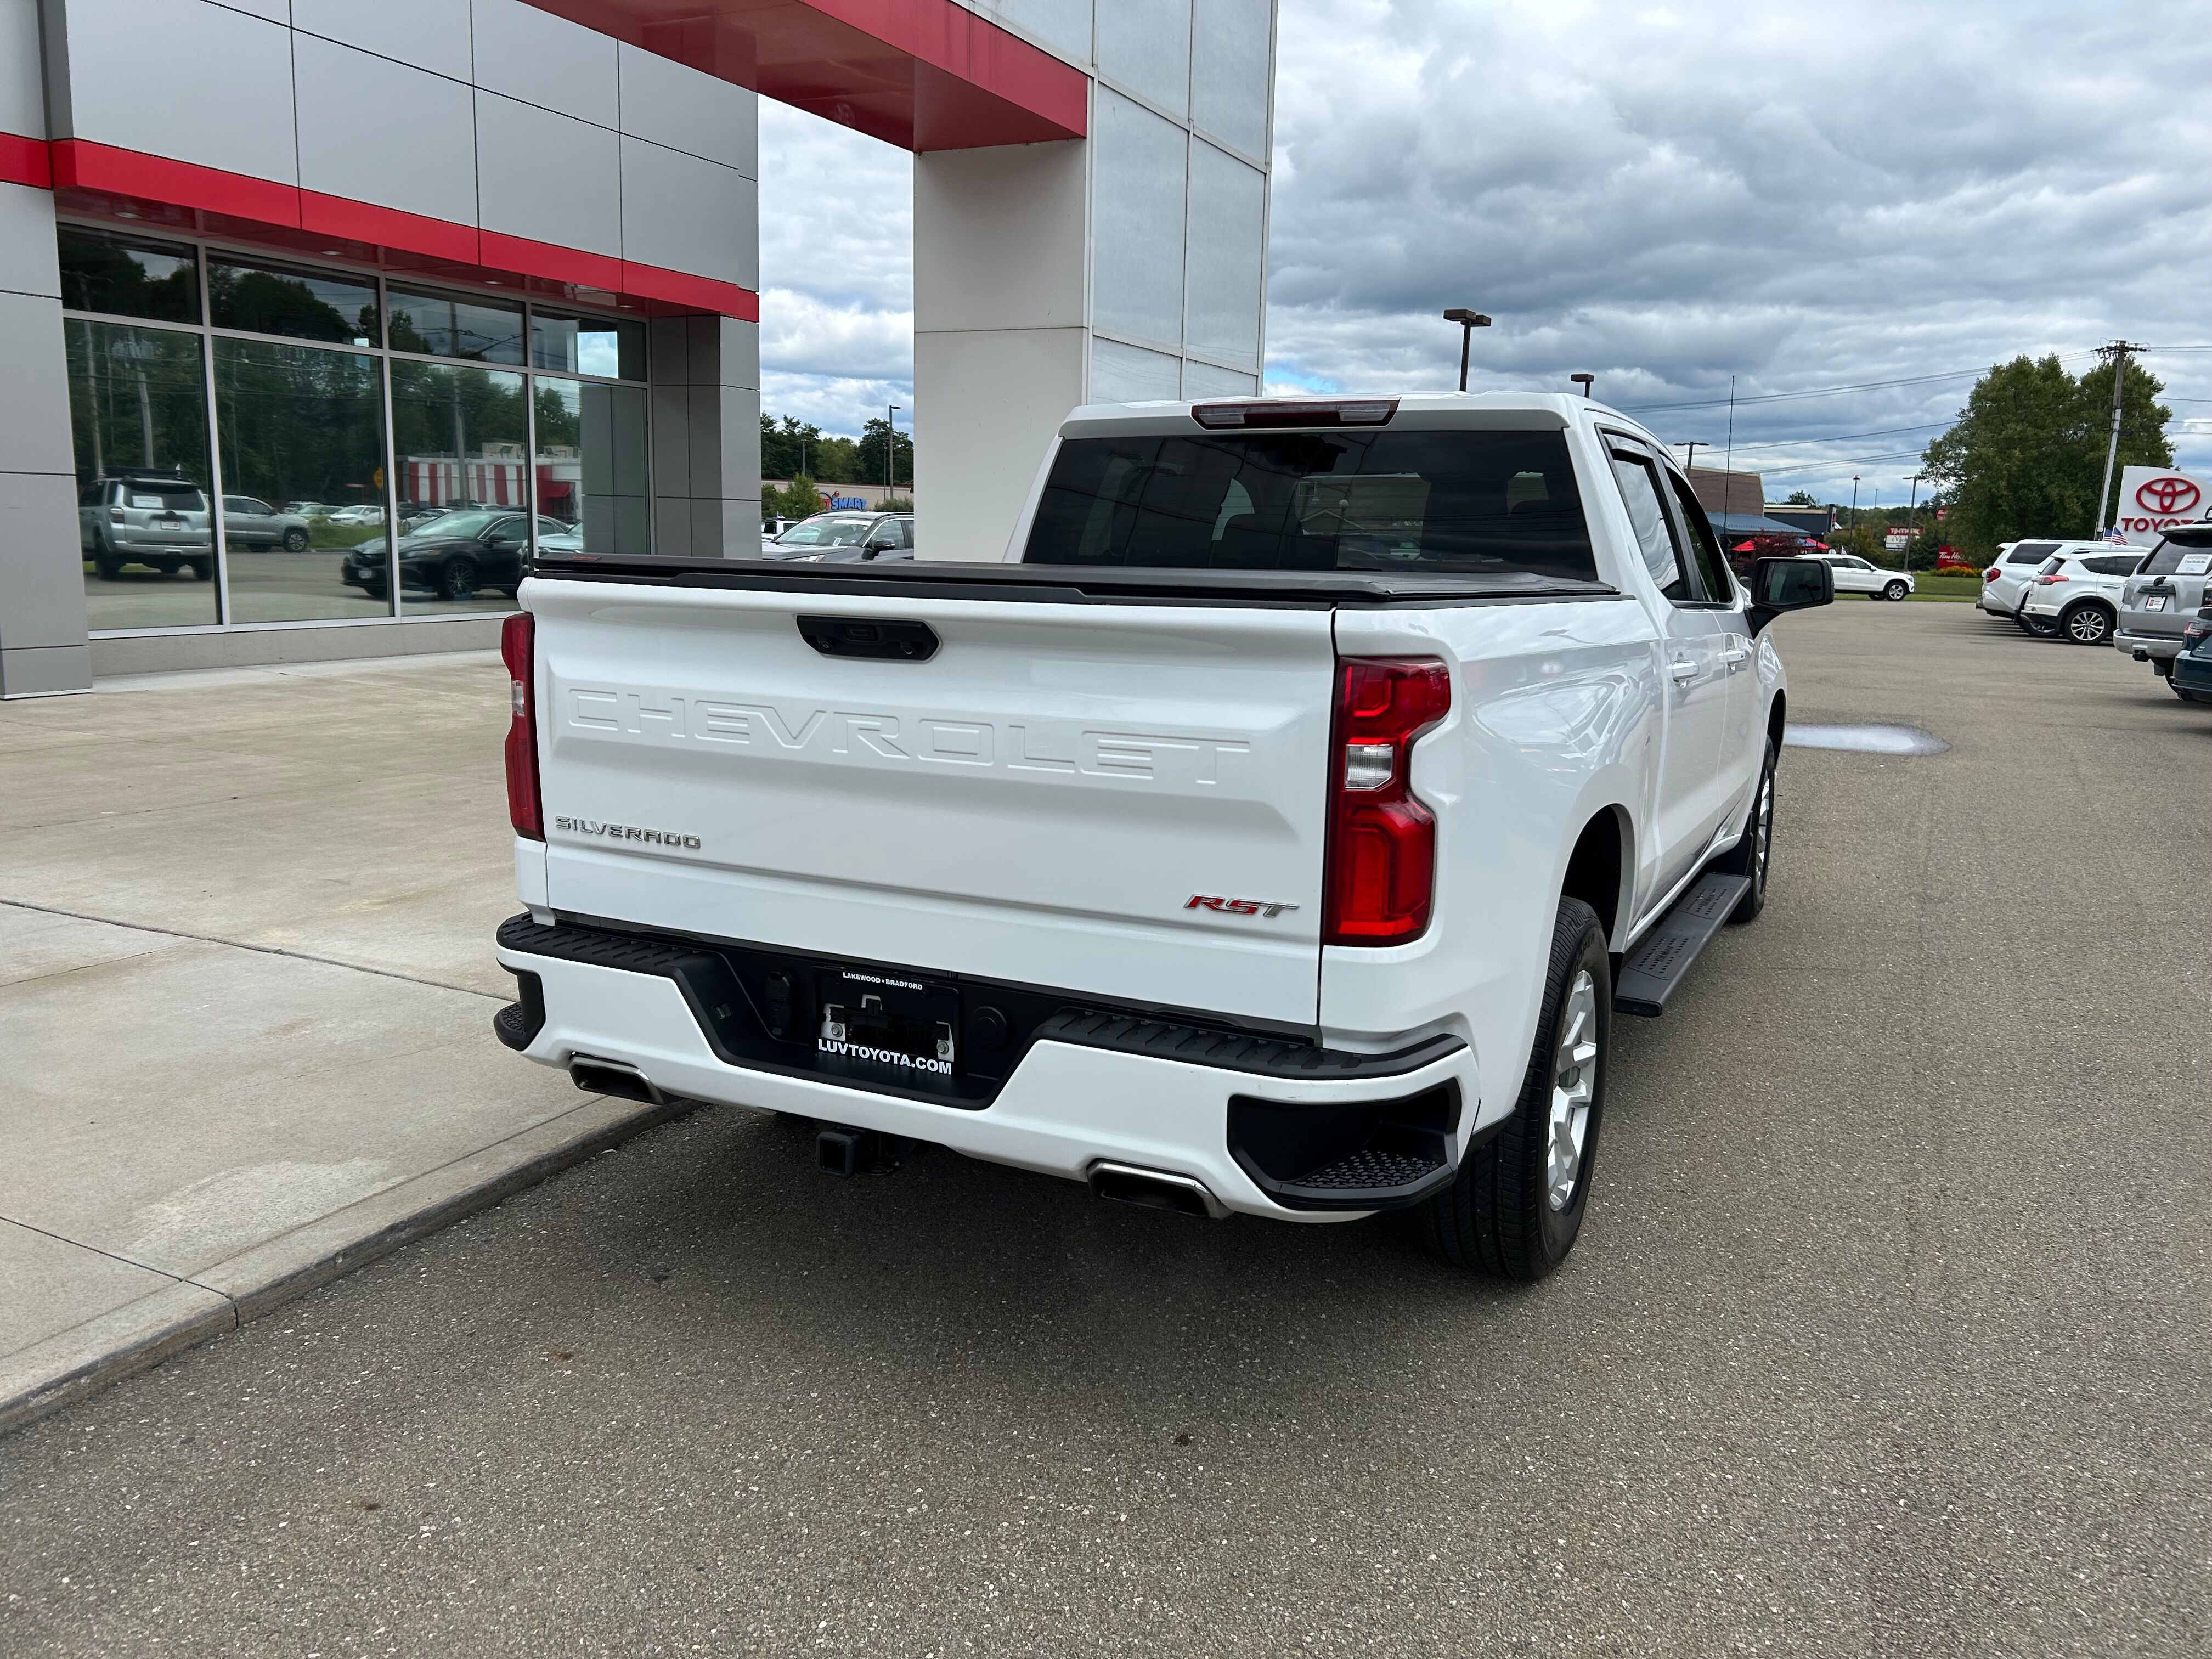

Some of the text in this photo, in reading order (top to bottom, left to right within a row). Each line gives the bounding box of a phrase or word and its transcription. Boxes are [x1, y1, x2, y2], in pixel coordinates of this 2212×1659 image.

[2121, 517, 2194, 532] TOYO
[568, 688, 1250, 785] CHEVROLET
[555, 815, 701, 850] SILVERADO
[1182, 893, 1300, 918] RST
[842, 972, 923, 990] LAKEWOOD BRADFORD
[817, 1037, 952, 1075] LUVTOYOTA.COM
